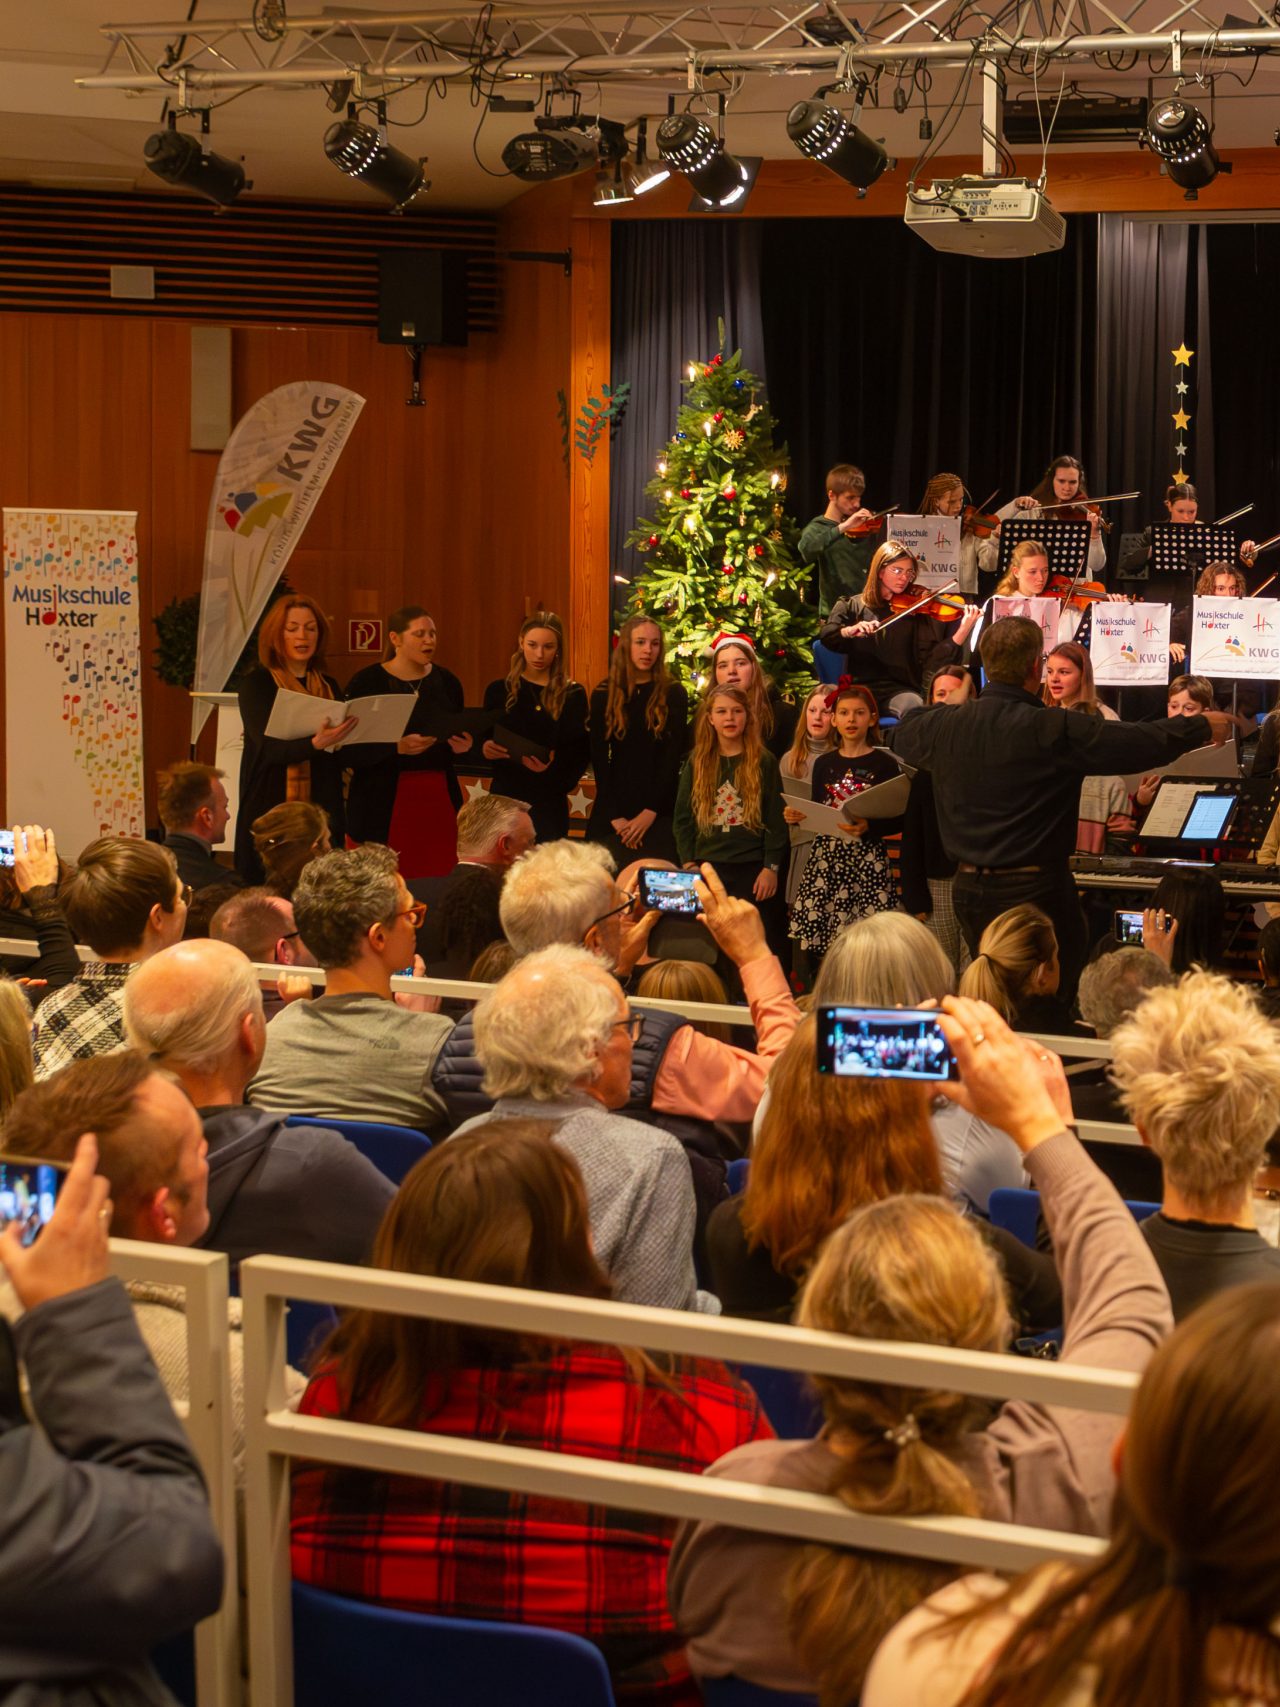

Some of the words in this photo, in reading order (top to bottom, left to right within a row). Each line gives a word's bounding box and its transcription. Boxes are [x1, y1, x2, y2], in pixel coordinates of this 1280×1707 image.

[277, 395, 341, 482] KWG
[931, 563, 957, 573] KWG
[12, 584, 132, 605] Musikschule
[26, 606, 98, 628] Höxter
[1197, 610, 1244, 620] Musikschule
[1096, 617, 1136, 626] Musikschule
[1249, 647, 1279, 658] KWG
[1139, 653, 1167, 663] KWG
